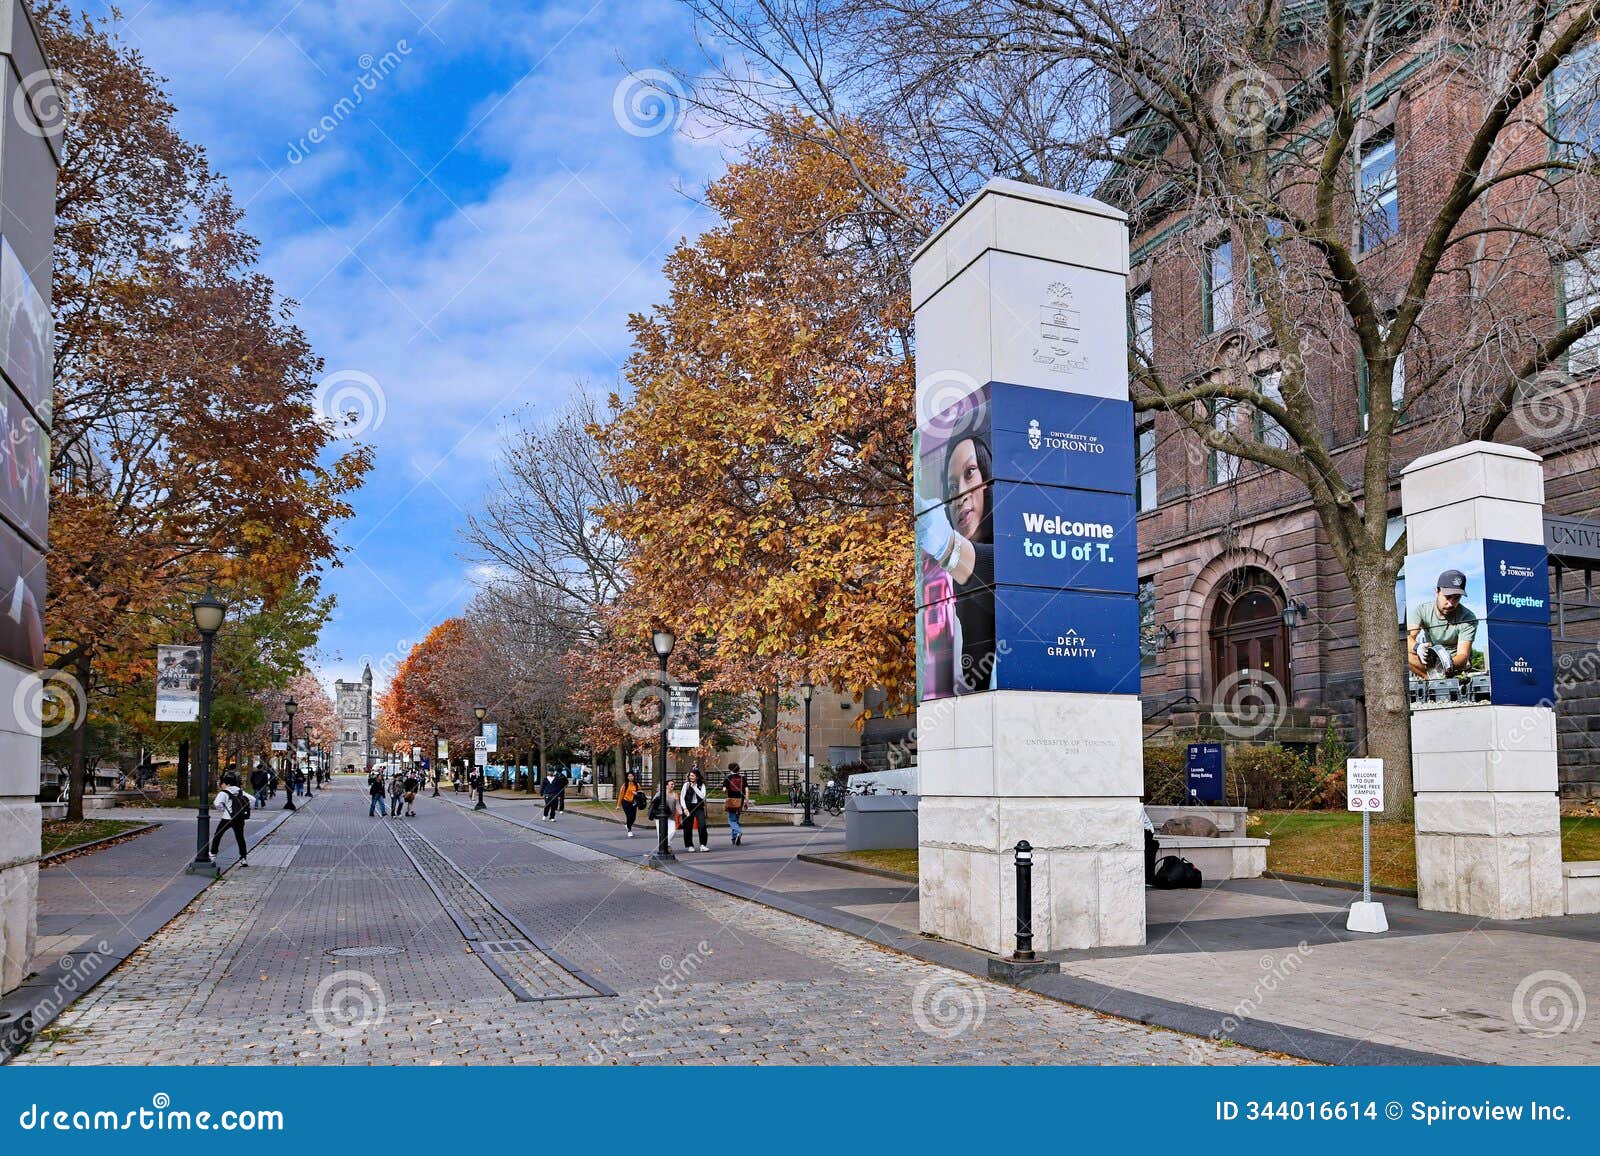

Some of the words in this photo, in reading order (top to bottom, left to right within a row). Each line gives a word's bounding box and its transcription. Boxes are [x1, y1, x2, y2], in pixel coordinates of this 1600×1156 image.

[1050, 431, 1087, 440] UNIVERSITY
[1044, 438, 1104, 453] TORONTO
[1022, 512, 1114, 539] Welcome
[1023, 538, 1045, 557] to
[1051, 539, 1067, 559] U
[1071, 542, 1092, 561] of
[1096, 543, 1114, 563] T.
[1507, 569, 1535, 578] TORONTO
[1493, 592, 1544, 608] #UTogether
[1057, 636, 1086, 646] DEFY
[1047, 646, 1097, 658] GRAVITY
